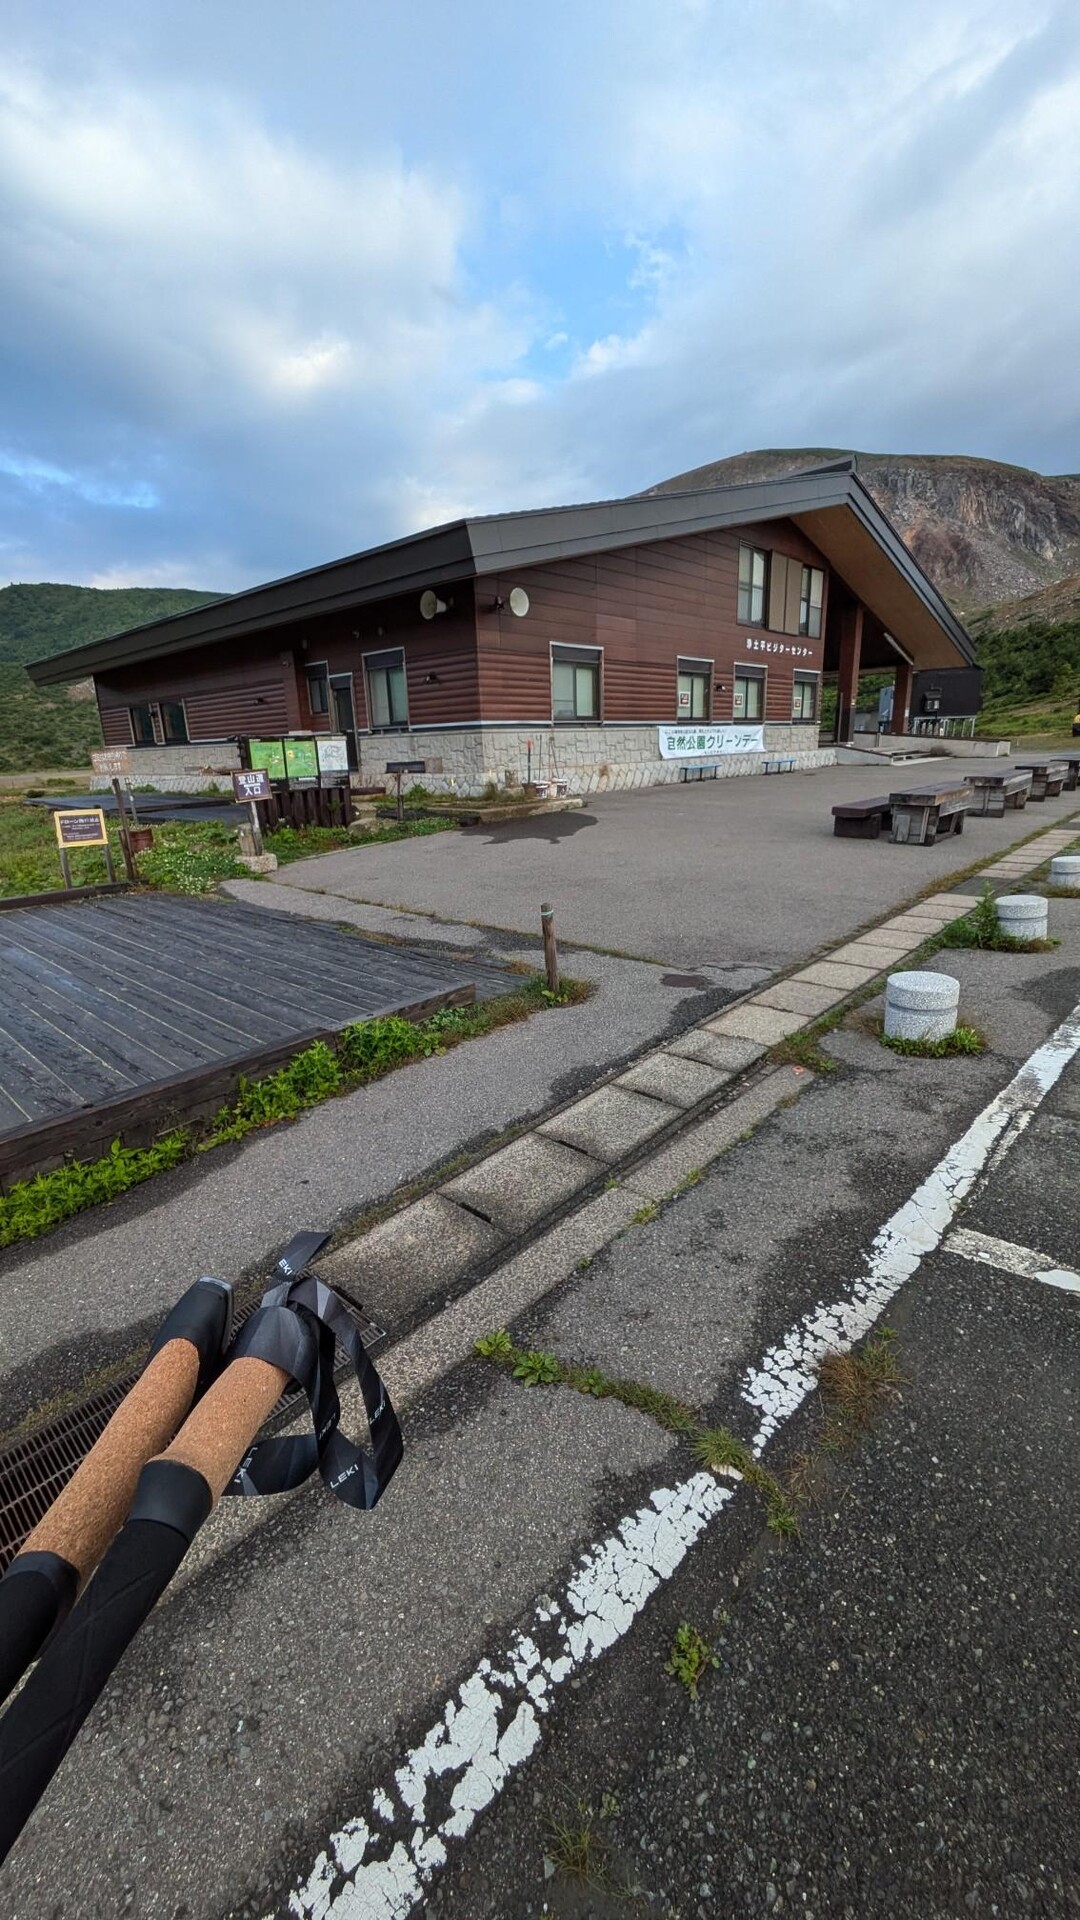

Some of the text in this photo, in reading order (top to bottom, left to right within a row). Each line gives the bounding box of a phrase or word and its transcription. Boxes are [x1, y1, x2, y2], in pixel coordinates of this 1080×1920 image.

[666, 734, 759, 751] 自然公園クリーンデー
[245, 785, 262, 796] 入口
[369, 1400, 386, 1425] LEKI
[234, 1447, 258, 1483] LEKI
[330, 1463, 359, 1489] LEKI
